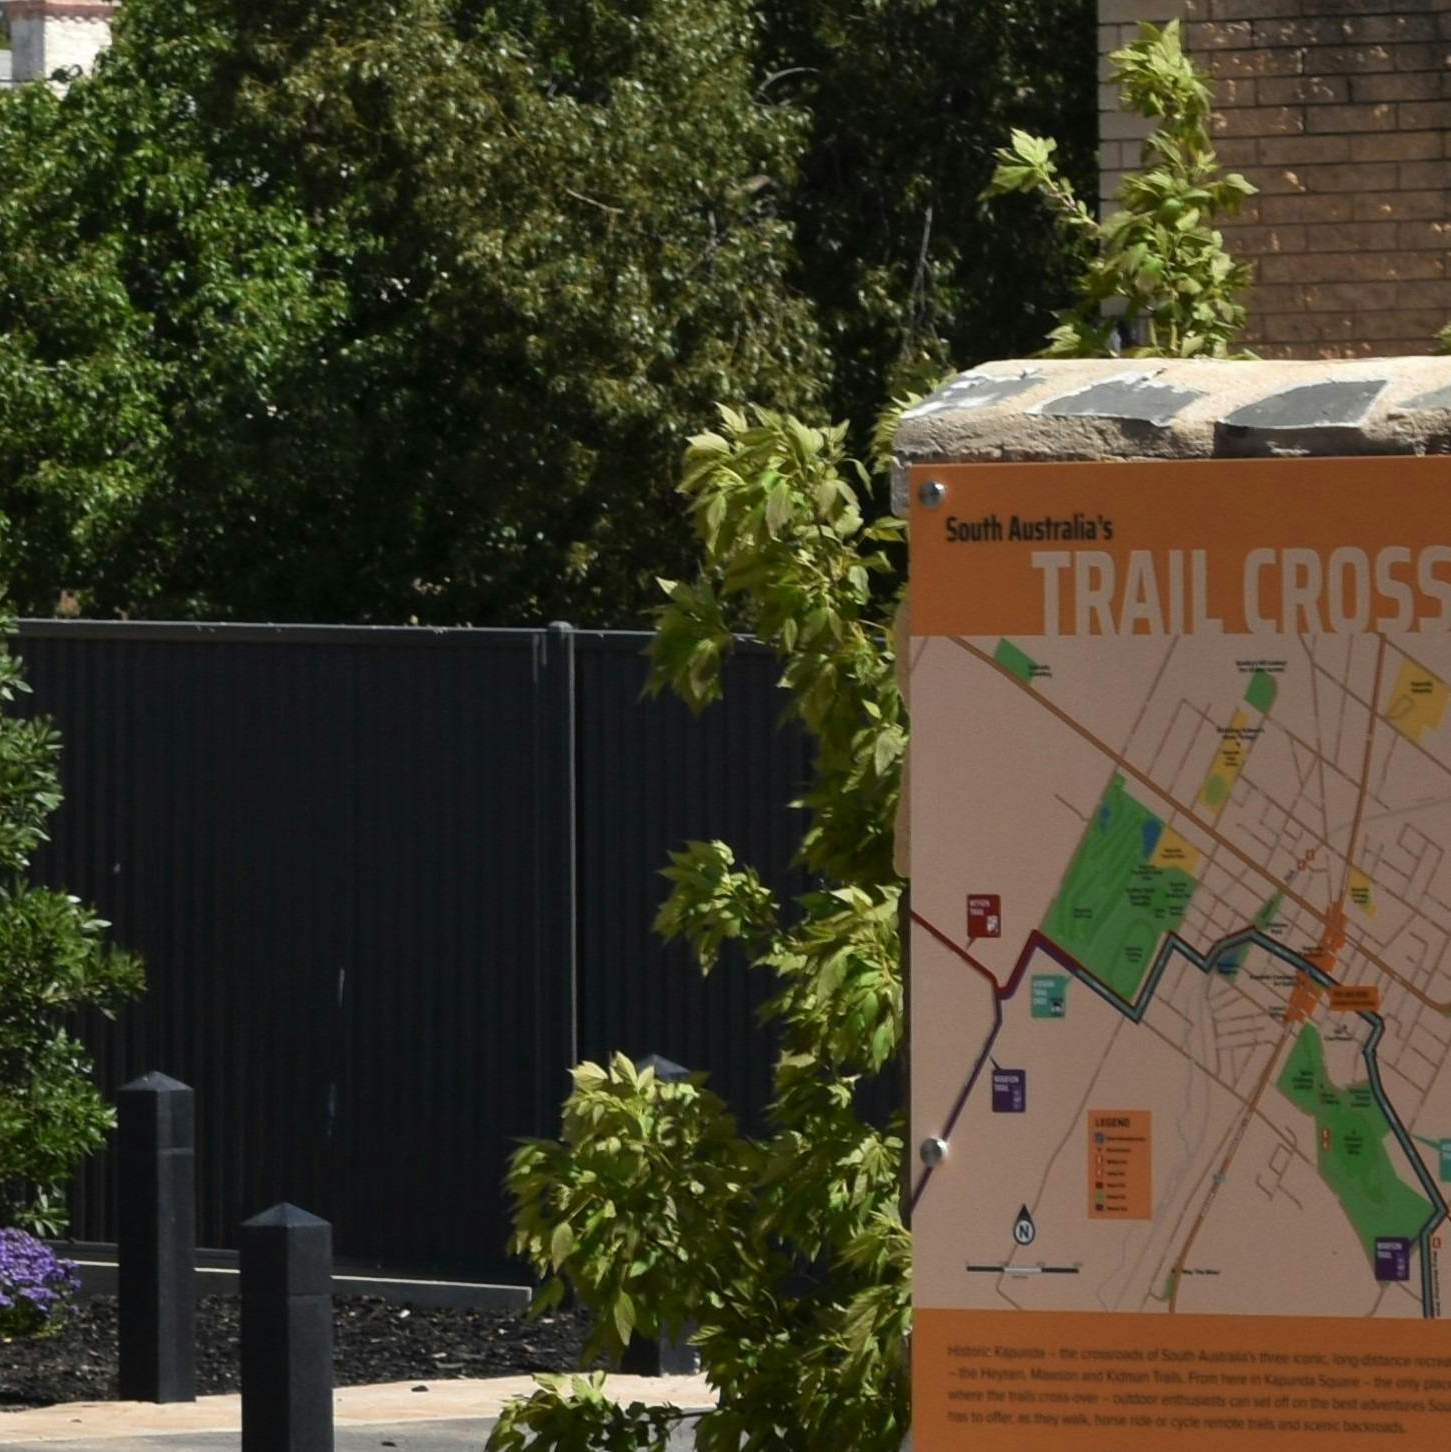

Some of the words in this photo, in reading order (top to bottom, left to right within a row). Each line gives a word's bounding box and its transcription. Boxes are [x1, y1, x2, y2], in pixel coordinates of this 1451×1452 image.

[946, 514, 1003, 543] South
[1007, 512, 1114, 542] Australia's
[1031, 549, 1224, 635] TRAIL
[1243, 545, 1451, 634] CROSS
[1095, 1118, 1130, 1128] LEGEND
[1019, 1225, 1030, 1240] N
[947, 1345, 991, 1358] Historic
[994, 1345, 1045, 1360] Kapunda
[1059, 1348, 1078, 1359] the
[1080, 1348, 1145, 1360] crossroads
[1146, 1348, 1159, 1361] of
[1160, 1348, 1195, 1362] South
[1199, 1349, 1256, 1363] Australia's
[1259, 1352, 1289, 1364] three
[958, 1367, 977, 1379] the
[1030, 1368, 1078, 1380] Mawson
[1081, 1369, 1103, 1381] and
[1106, 1370, 1149, 1383] Kidman
[1188, 1371, 1218, 1384] From
[1221, 1373, 1247, 1385] here
[1264, 1374, 1315, 1388] Kapunda
[1373, 1376, 1392, 1388] the
[986, 1390, 1006, 1401] the
[1113, 1393, 1158, 1405] outdoor
[1228, 1397, 1251, 1408] can
[1253, 1397, 1271, 1408] set
[1274, 1395, 1289, 1408] off
[1291, 1398, 1307, 1409] on
[1310, 1397, 1329, 1409] the
[1331, 1397, 1358, 1410] best
[947, 1410, 969, 1422] has
[971, 1411, 983, 1423] to
[1018, 1413, 1031, 1424] as
[1033, 1412, 1058, 1426] they
[1094, 1413, 1127, 1426] horse
[1129, 1413, 1153, 1426] ride
[1170, 1415, 1201, 1430] cycle
[1203, 1418, 1245, 1430] remote
[1277, 1419, 1301, 1431] and
